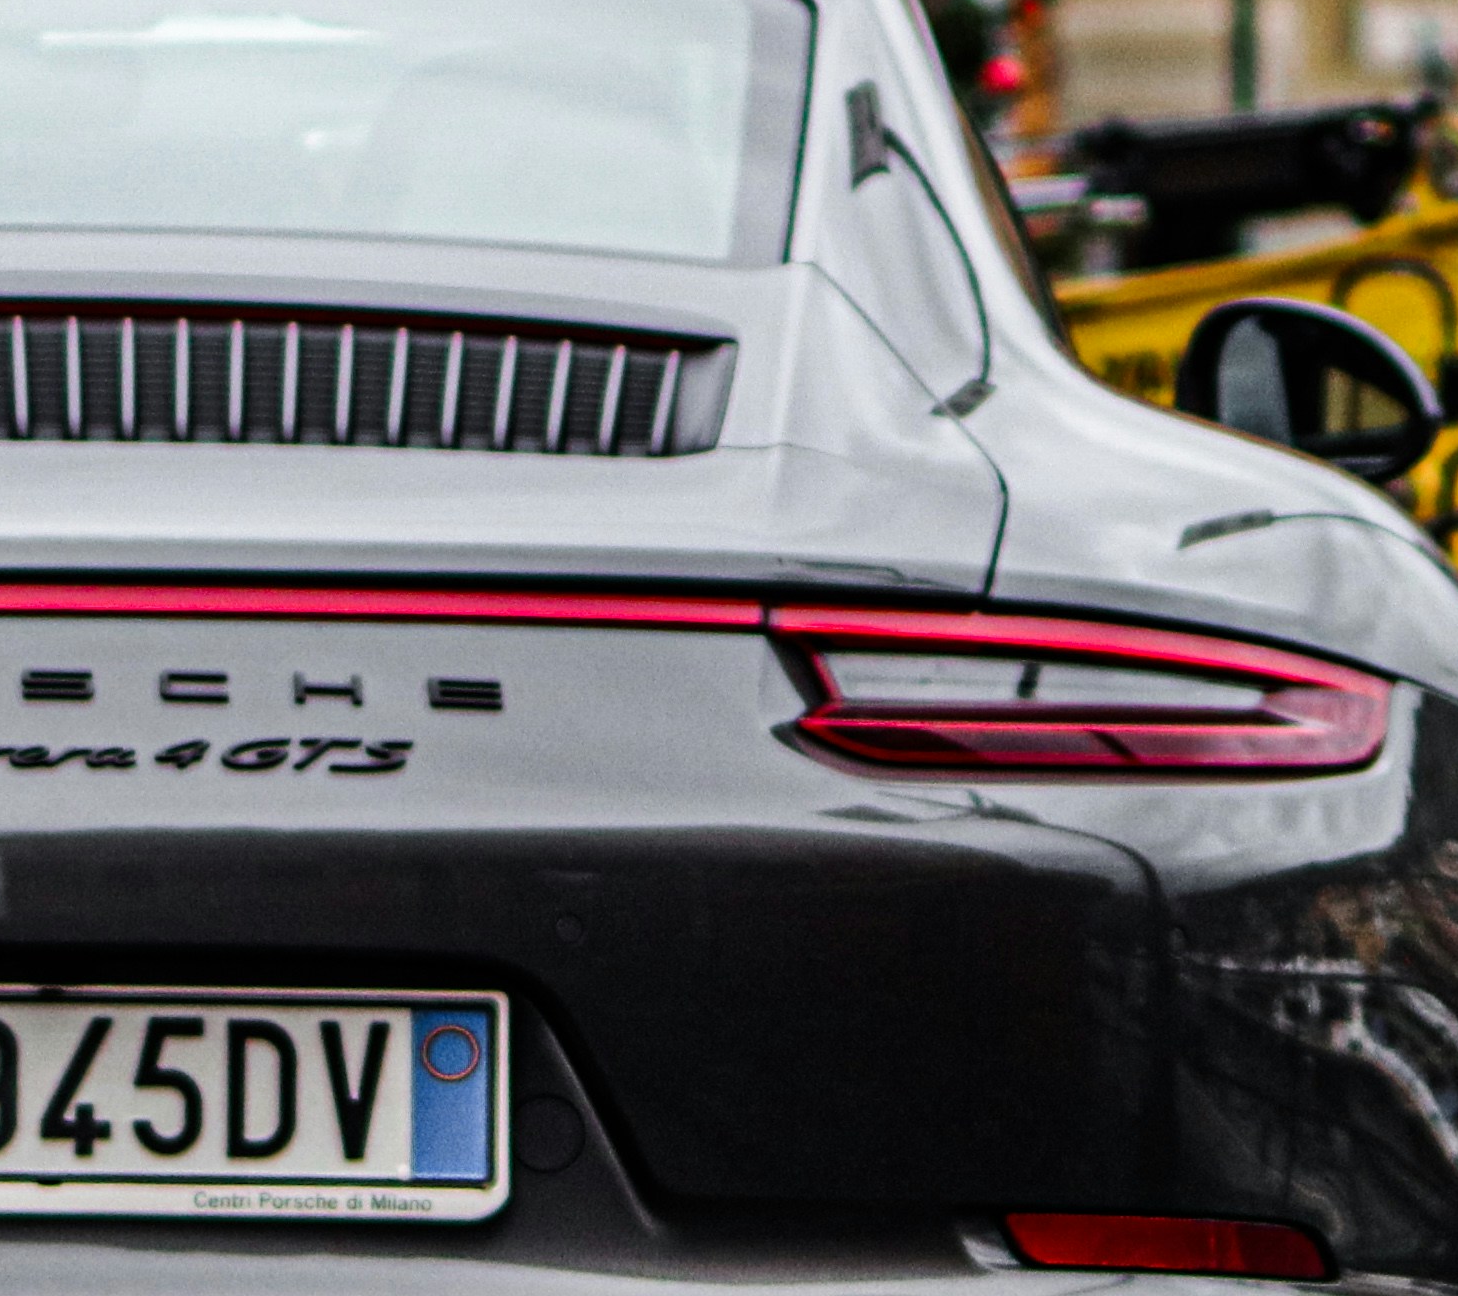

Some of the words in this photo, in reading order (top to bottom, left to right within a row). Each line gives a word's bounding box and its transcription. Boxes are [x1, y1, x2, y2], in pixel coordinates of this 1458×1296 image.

[220, 738, 414, 773] GTS
[193, 1190, 252, 1210] Centri
[259, 1192, 338, 1211] Porsche
[346, 1193, 364, 1211] di
[370, 1194, 432, 1212] Milano
